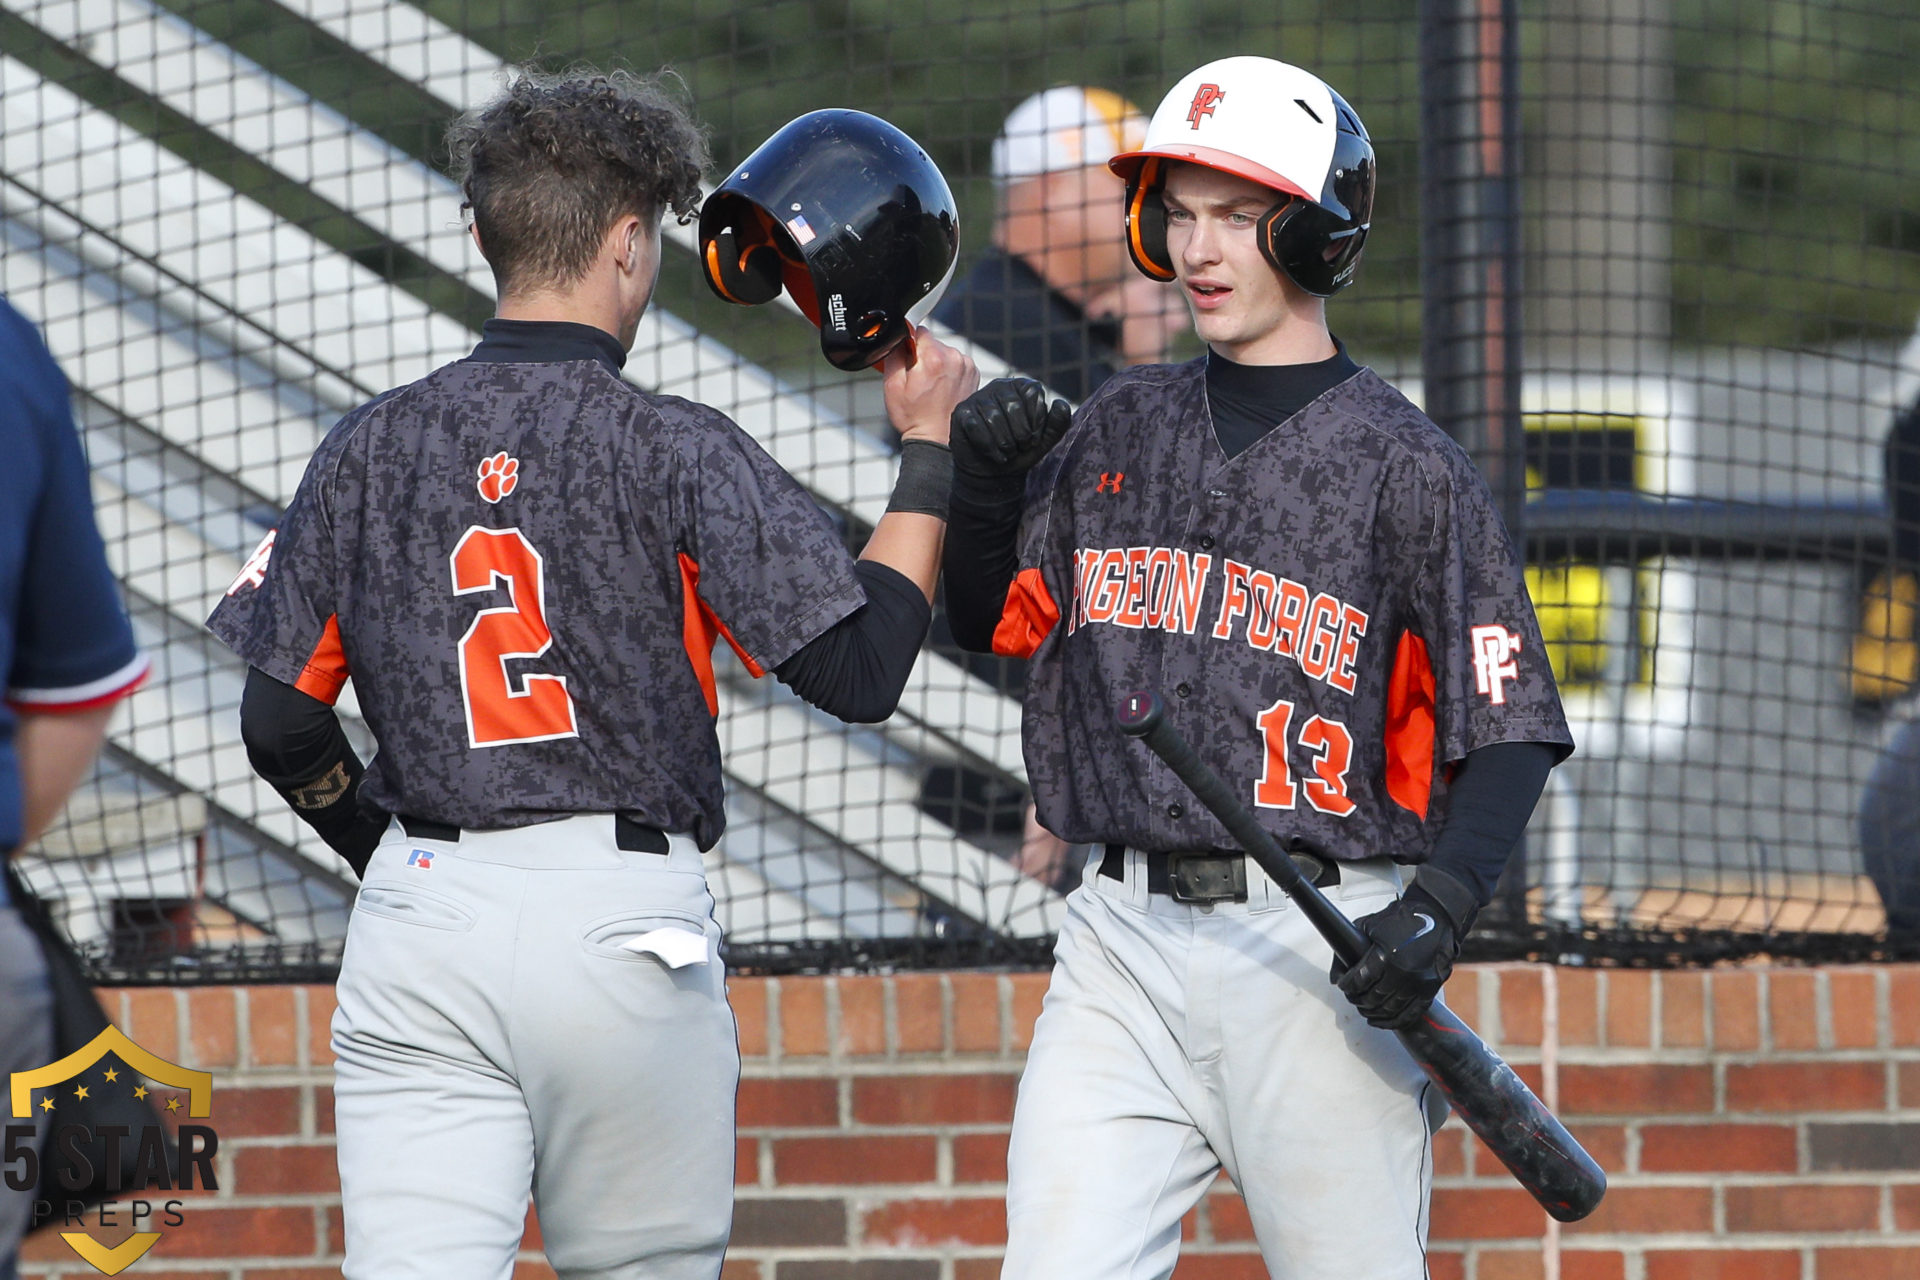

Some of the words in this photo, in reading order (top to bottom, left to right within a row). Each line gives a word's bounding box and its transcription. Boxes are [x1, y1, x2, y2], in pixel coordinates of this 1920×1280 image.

[831, 293, 847, 331] schutt
[450, 525, 579, 749] 2
[1068, 546, 1212, 636] PIGEON
[1212, 558, 1369, 696] FORGE
[1254, 699, 1357, 817] 13
